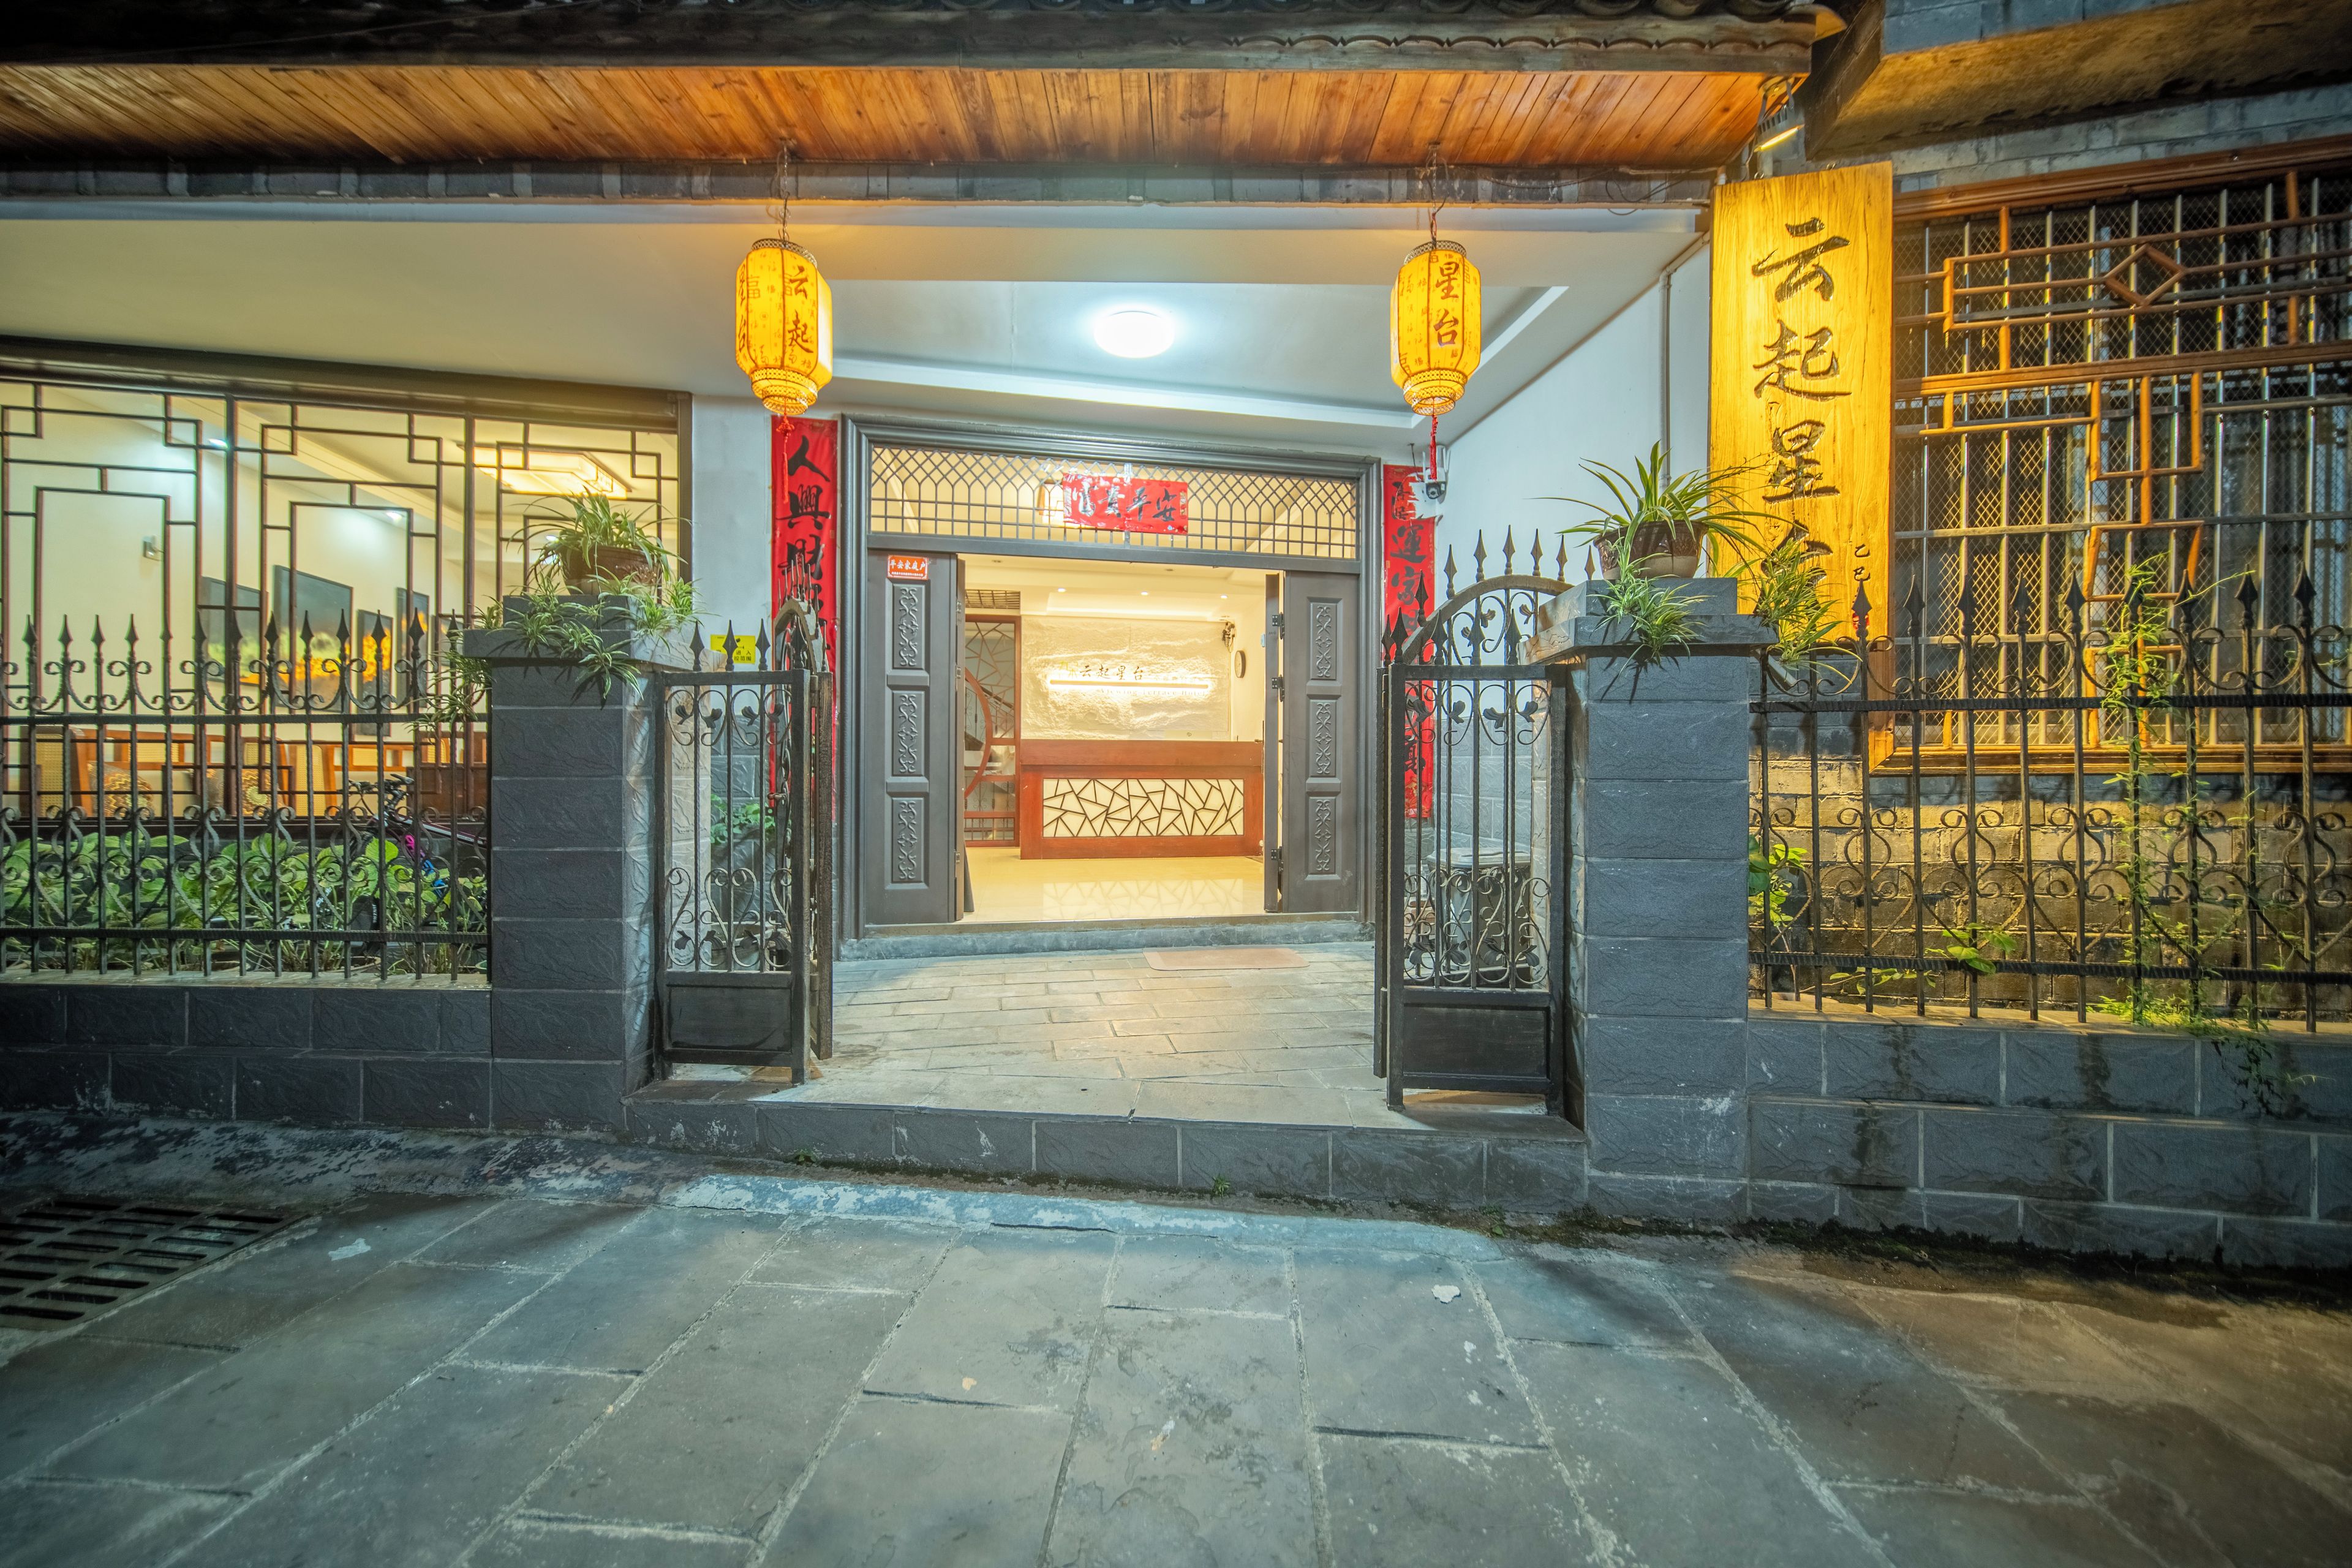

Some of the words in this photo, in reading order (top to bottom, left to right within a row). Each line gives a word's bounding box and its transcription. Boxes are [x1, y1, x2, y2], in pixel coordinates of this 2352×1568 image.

[787, 265, 813, 353] 云起
[1434, 262, 1459, 347] 星台
[890, 559, 925, 571] 平安家庭户
[1080, 664, 1144, 680] 云起星台
